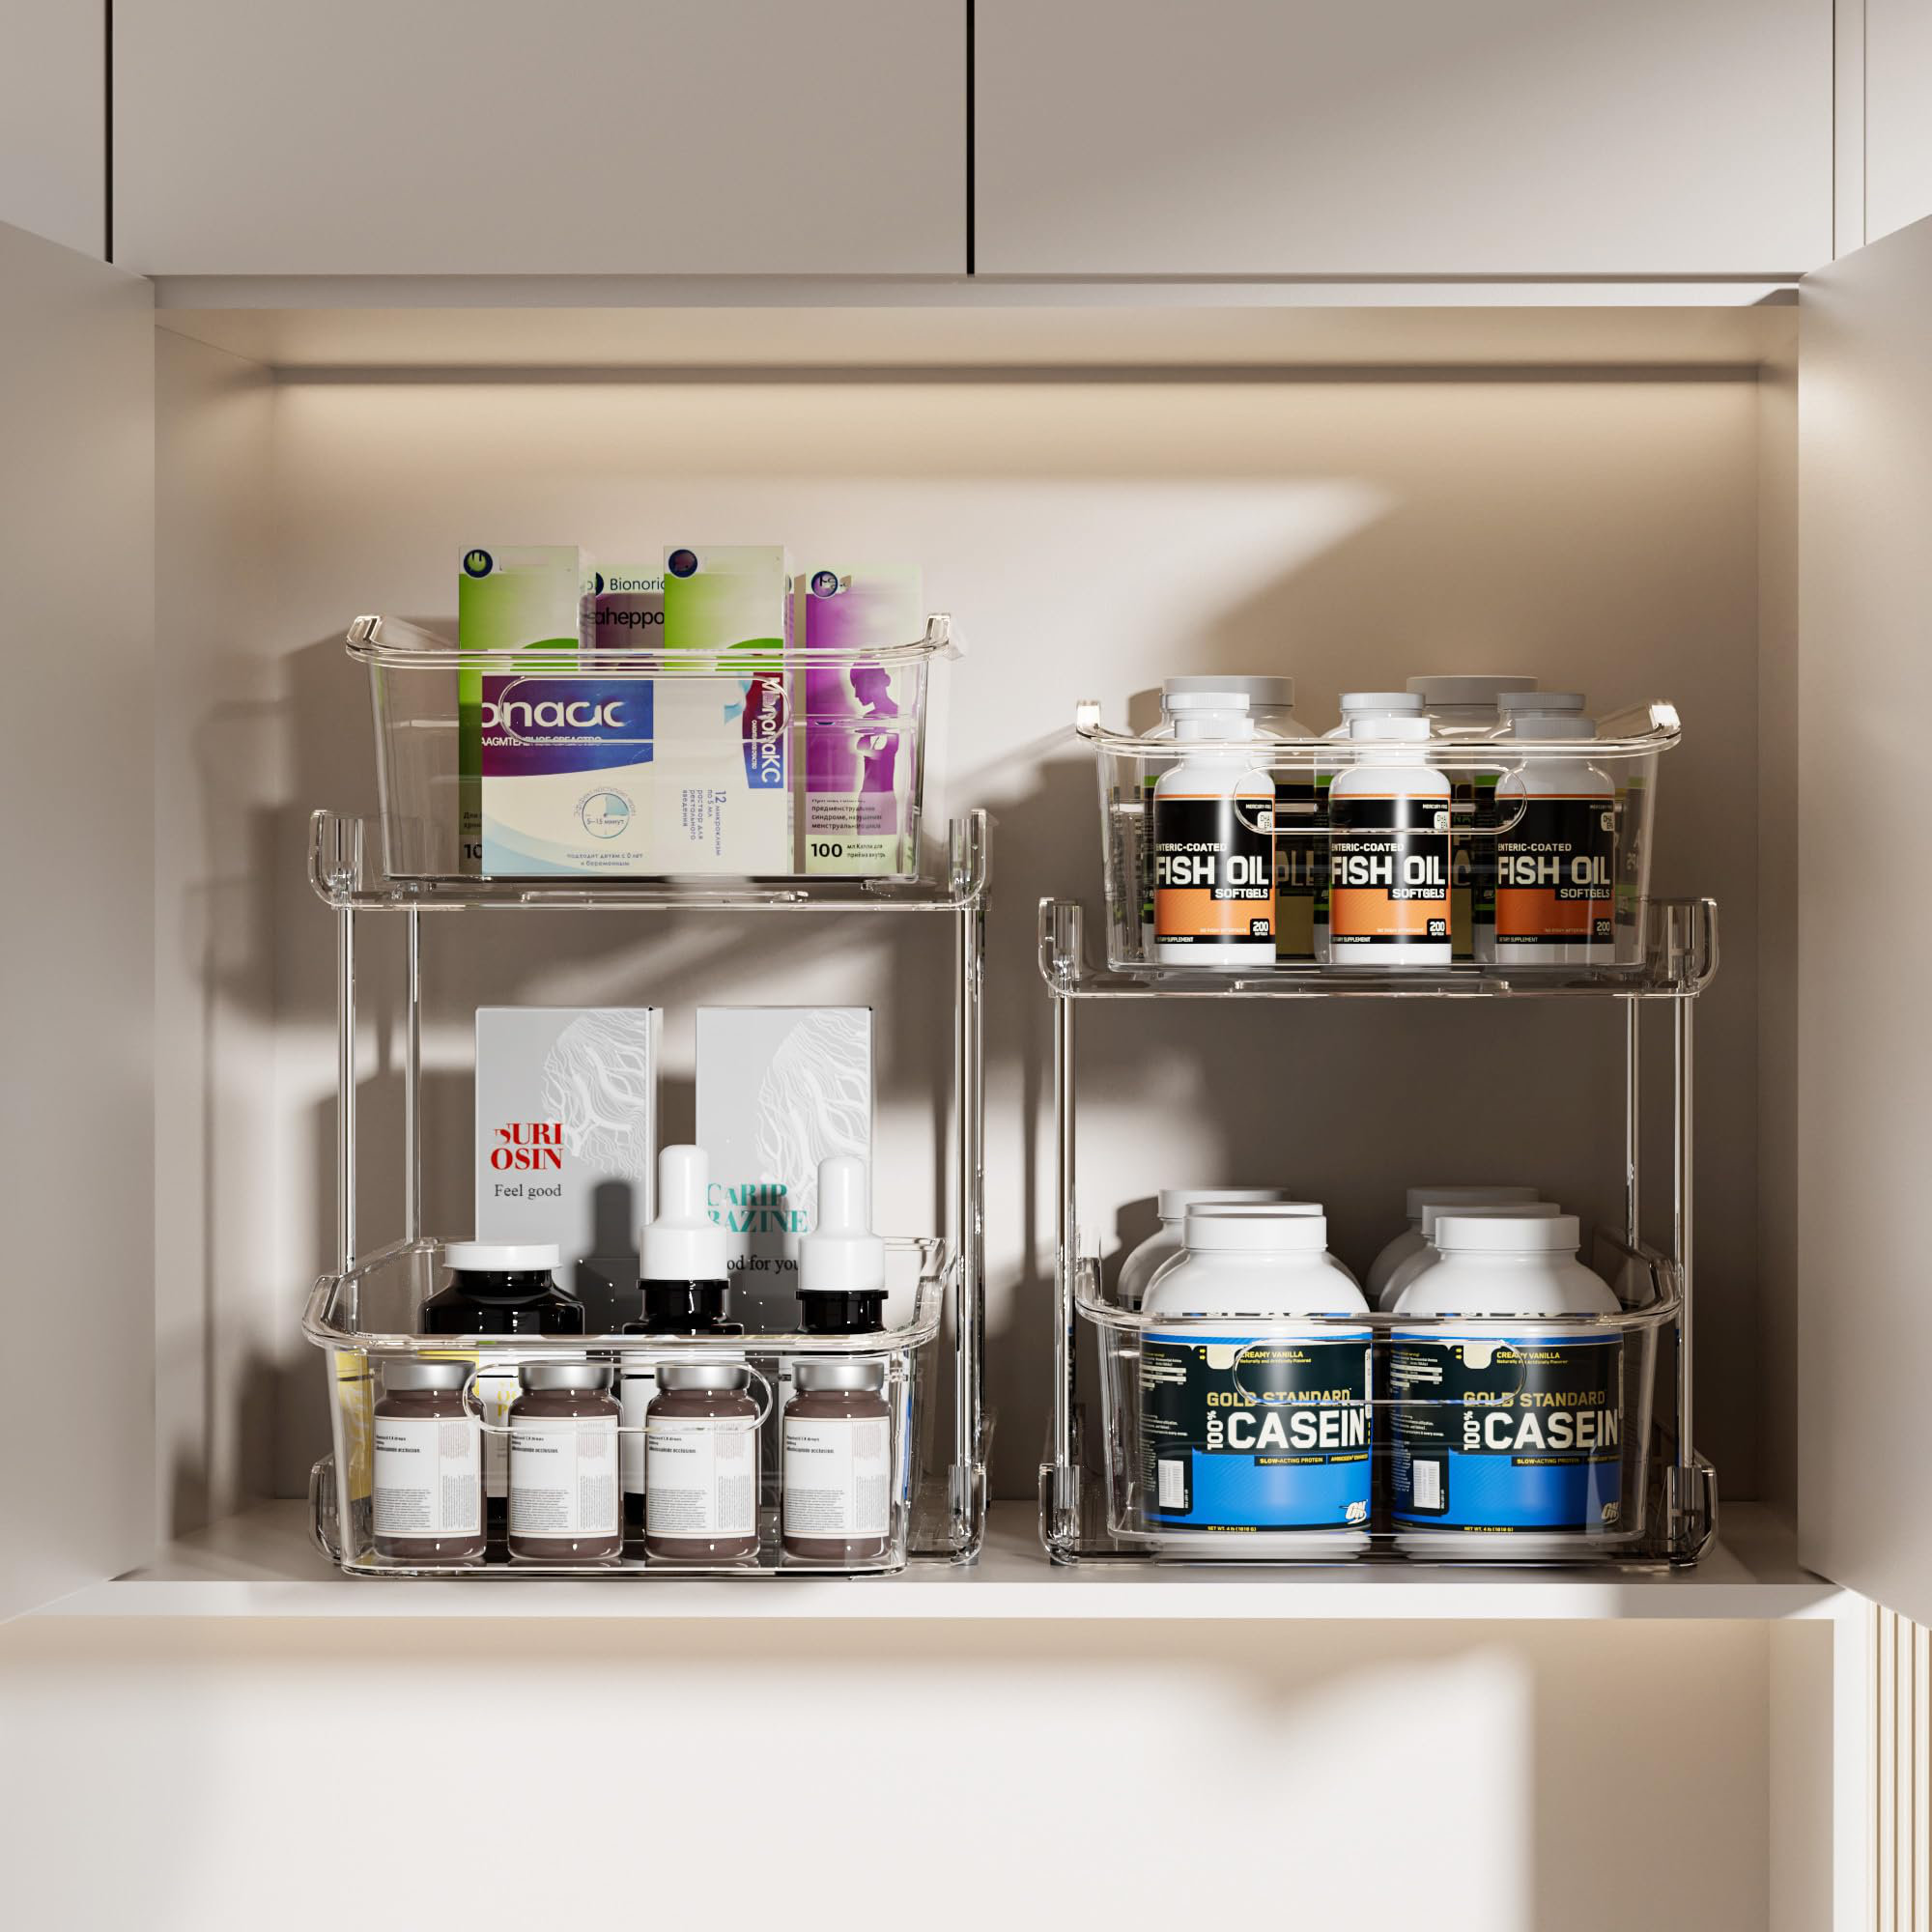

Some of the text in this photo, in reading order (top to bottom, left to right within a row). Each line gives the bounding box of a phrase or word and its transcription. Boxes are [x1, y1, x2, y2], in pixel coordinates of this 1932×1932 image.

[715, 790, 726, 803] 12
[810, 843, 842, 858] 100
[1498, 843, 1572, 852] ENTERIC-COATED
[1156, 856, 1268, 885] FISH OIL
[1331, 856, 1445, 885] FISH OIL
[1498, 856, 1610, 885] FISH OIL
[1215, 888, 1268, 898] SOFTGELS
[1392, 888, 1444, 898] SOFTGELS
[1560, 888, 1610, 898] SOFTGELS
[1252, 921, 1268, 932] 200
[1430, 921, 1445, 932] 200
[1596, 921, 1610, 932] 200
[491, 1148, 564, 1170] OSIN
[495, 1183, 562, 1201] Feel good
[750, 1254, 771, 1270] for
[1208, 1390, 1350, 1406] GOLD STANDARD
[1463, 1390, 1605, 1407] GOLD STANDARD
[1208, 1410, 1223, 1450] 100%
[1228, 1408, 1364, 1449] CASEIN
[1463, 1410, 1480, 1450] 100%
[1484, 1408, 1618, 1449] CASEIN
